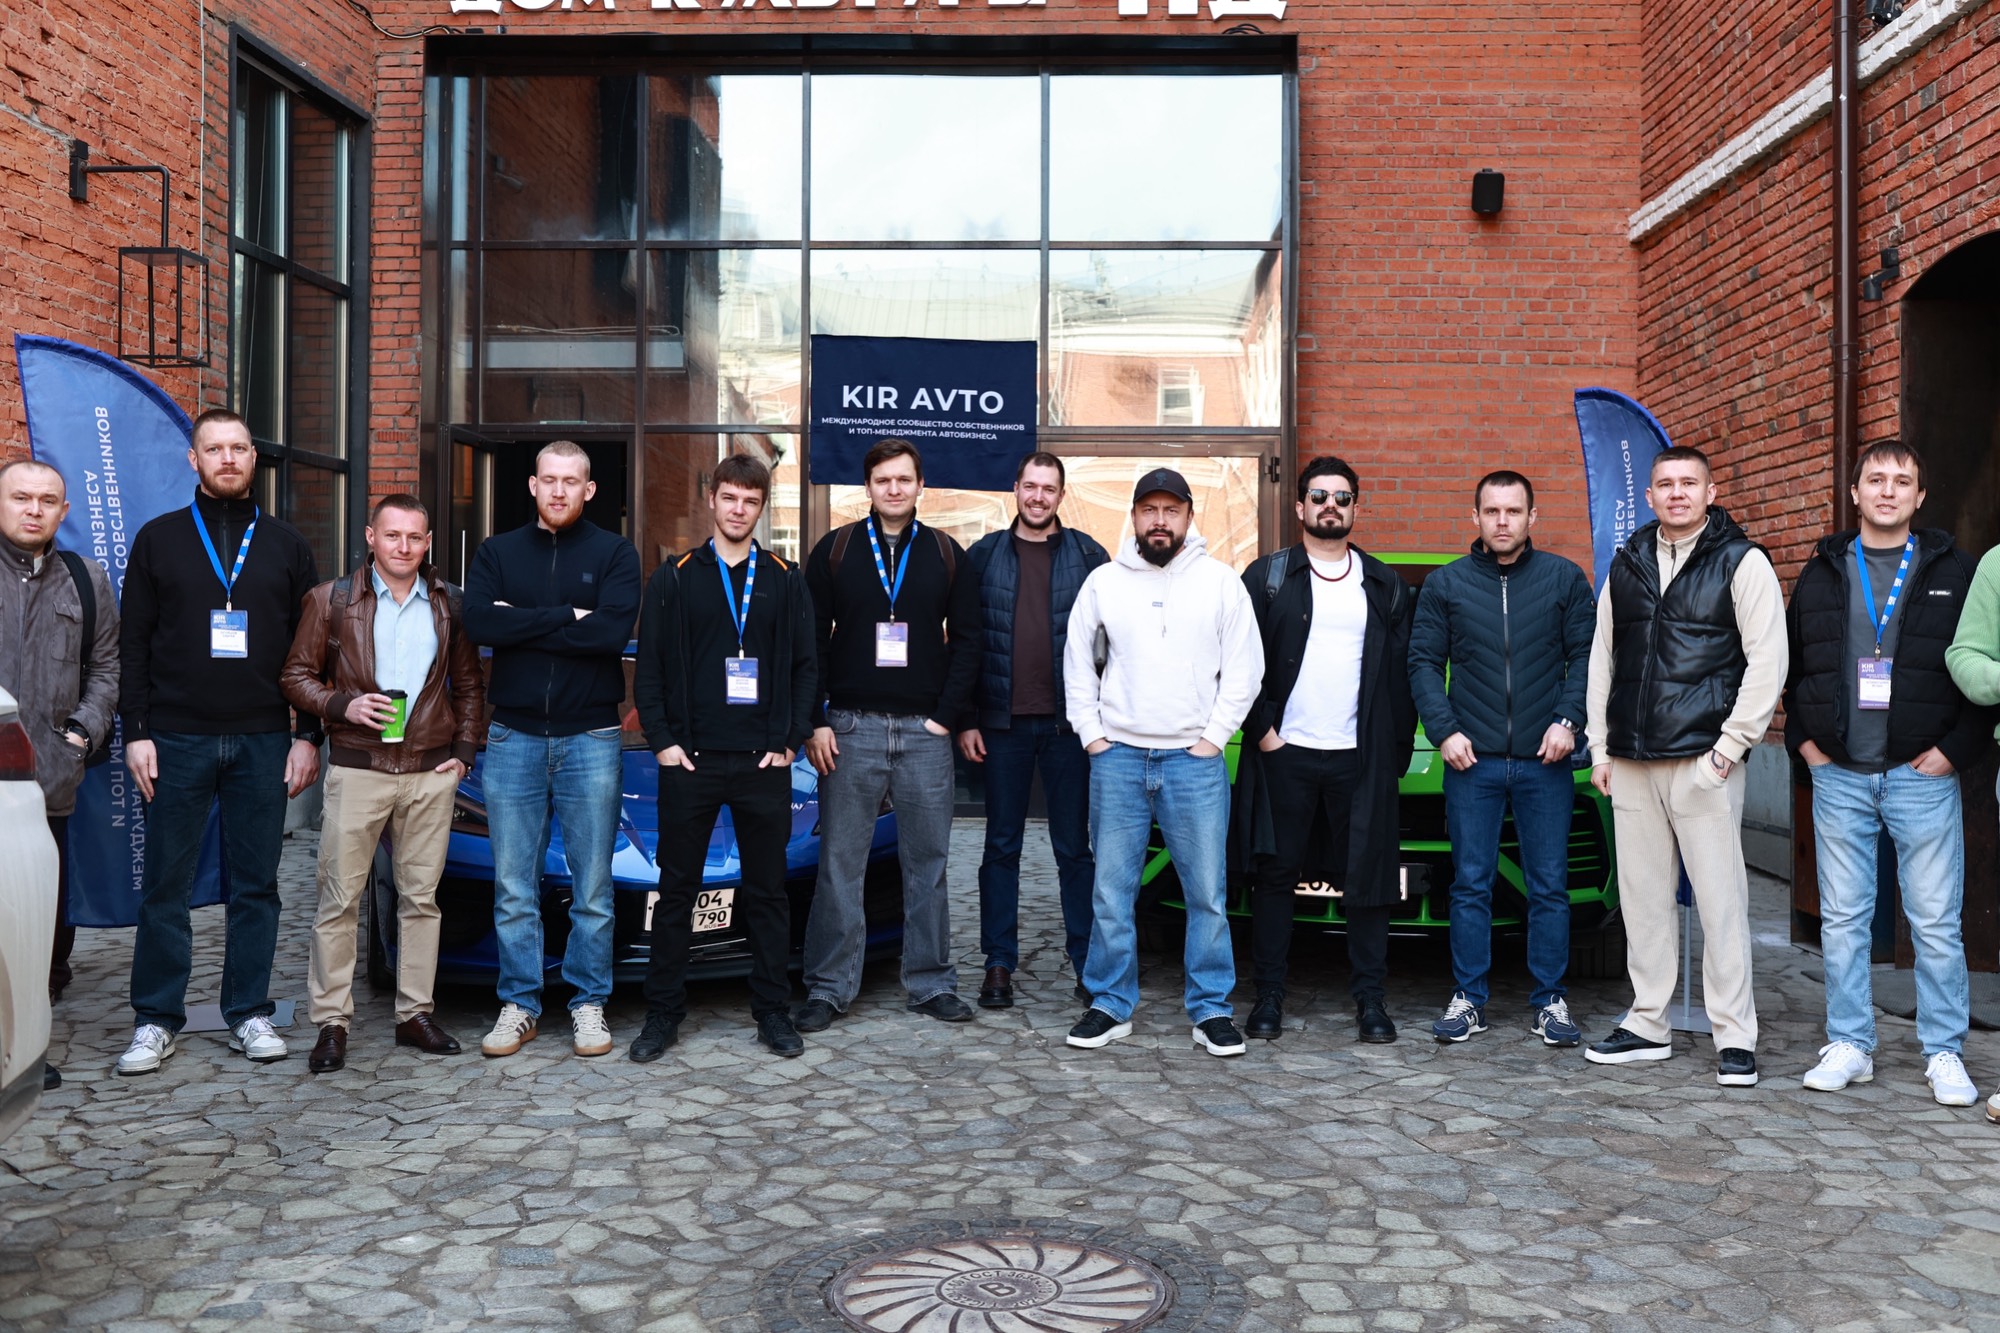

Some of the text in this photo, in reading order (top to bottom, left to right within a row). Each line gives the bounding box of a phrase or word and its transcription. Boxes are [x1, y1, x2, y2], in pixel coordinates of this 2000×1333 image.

[843, 385, 1004, 414] KIR AVTO
[822, 417, 1025, 431] МЕЖДУНАРОДНОЕ СООБЩЕСТВО СОБСТВЕННИКОВ
[856, 428, 937, 437] ТОП-МЕНЕДЖМЕНТА
[939, 431, 997, 440] АВТОБИЗНЕСА
[698, 910, 727, 927] 790
